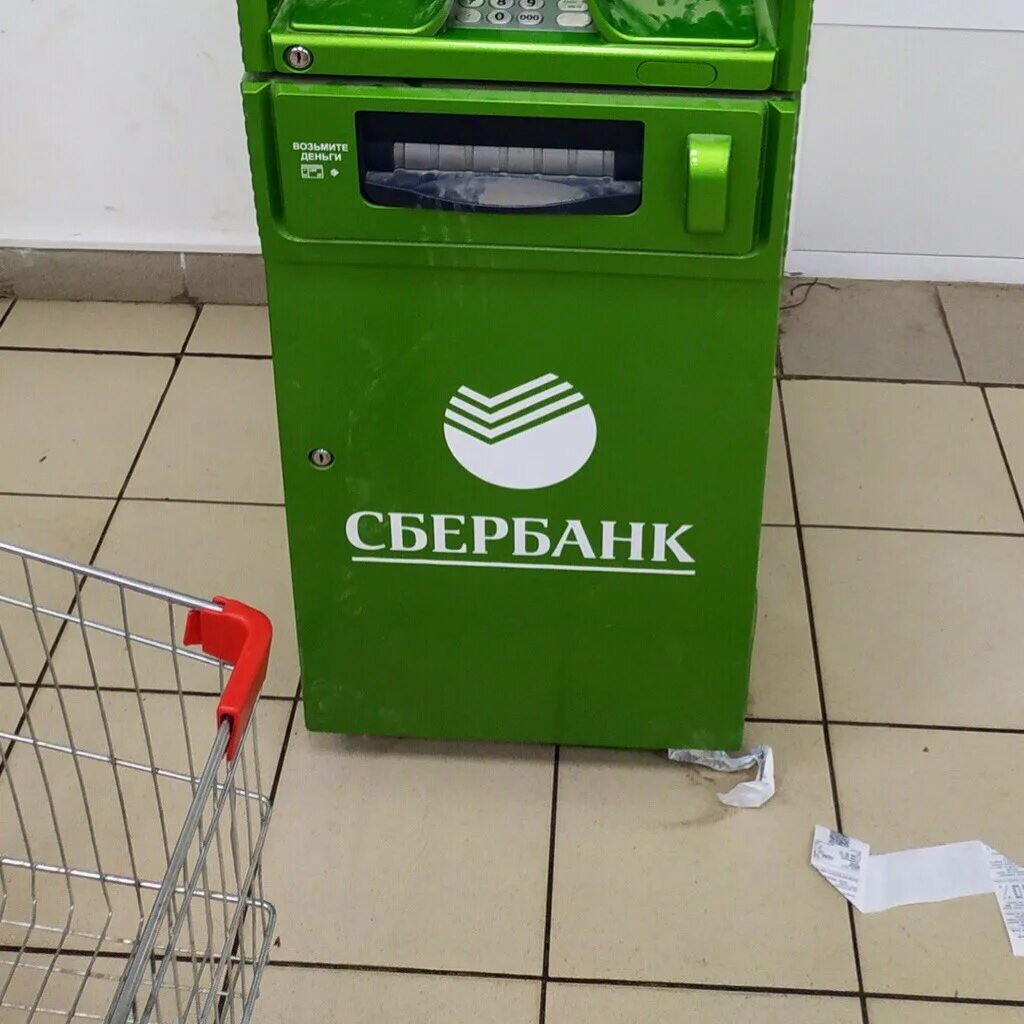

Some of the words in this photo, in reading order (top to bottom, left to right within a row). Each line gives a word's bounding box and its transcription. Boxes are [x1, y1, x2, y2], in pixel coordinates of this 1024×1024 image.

[527, 0, 536, 7] 9
[495, 12, 504, 20] 0
[292, 141, 349, 154] ВОЗЬМИТЕ
[300, 151, 342, 163] ДЕНЬГИ
[345, 510, 695, 564] СБЕРБАНК
